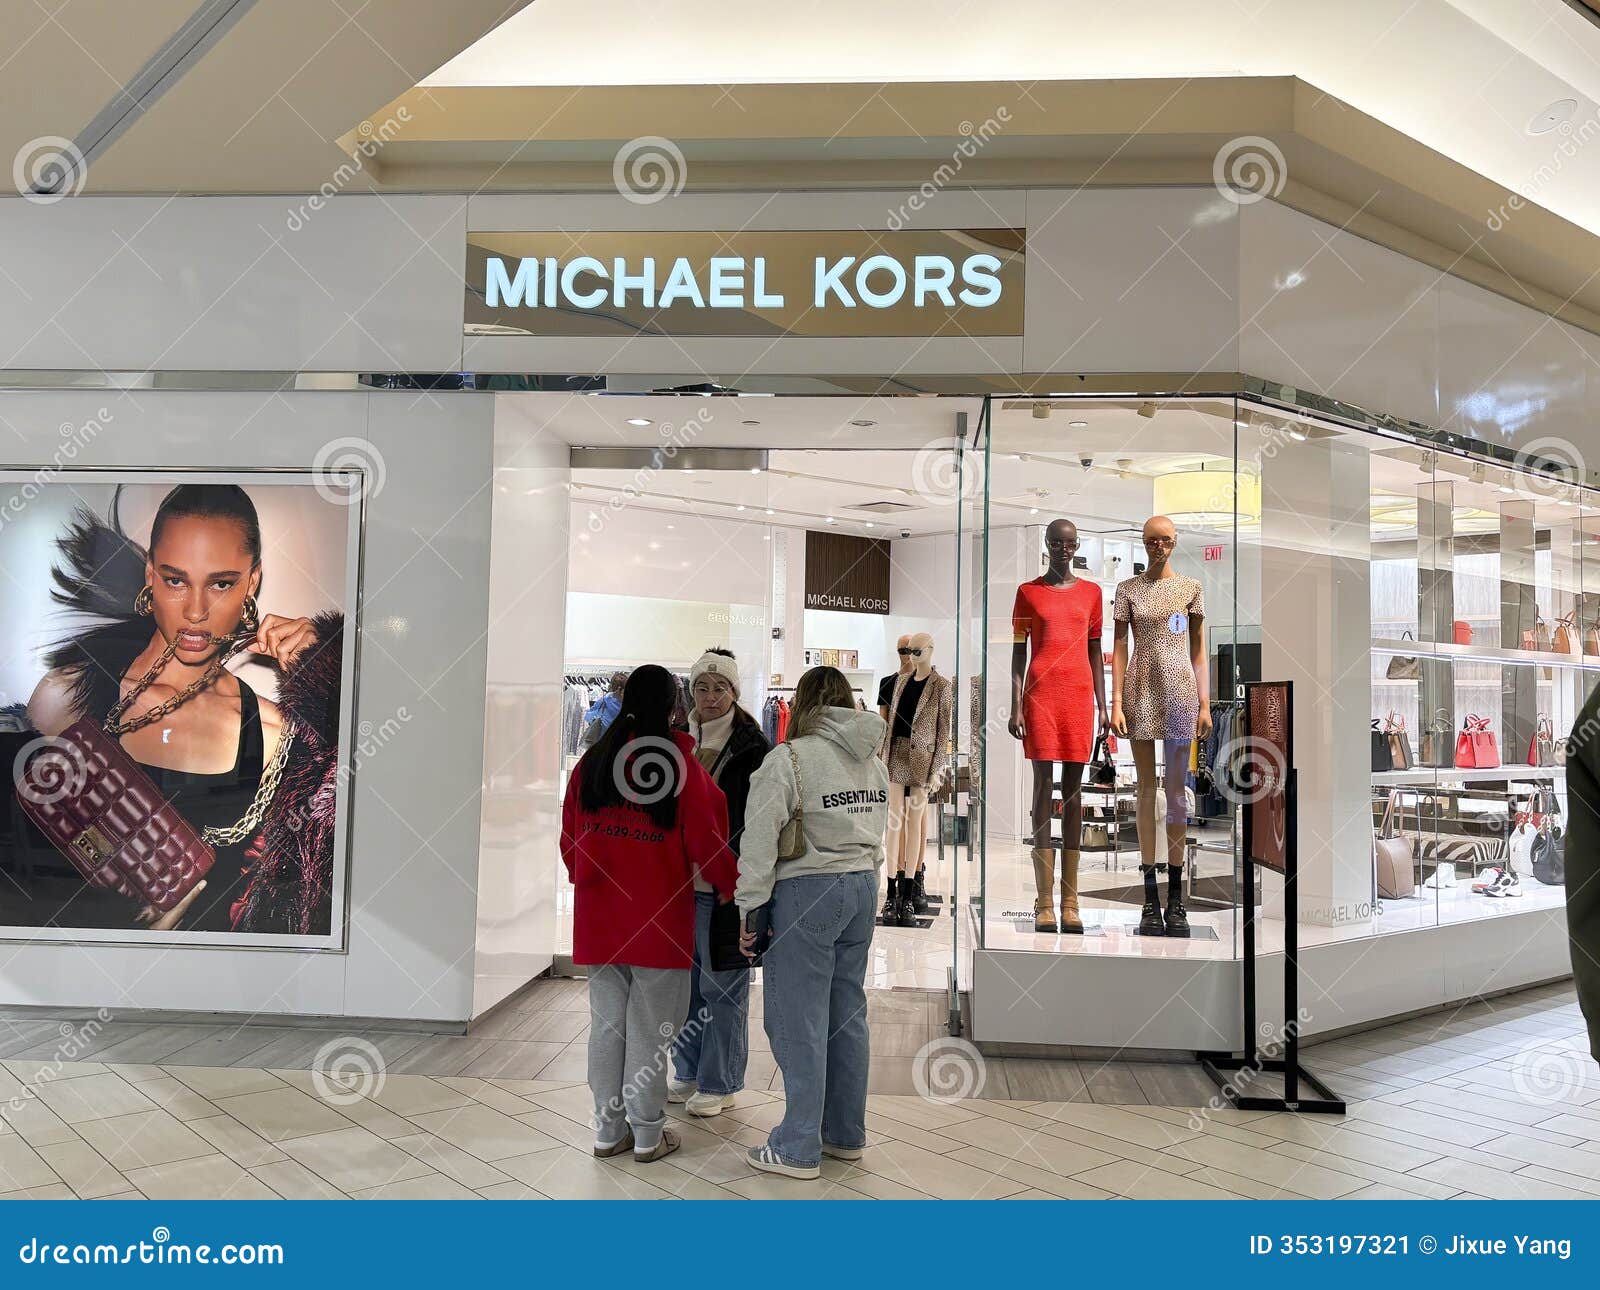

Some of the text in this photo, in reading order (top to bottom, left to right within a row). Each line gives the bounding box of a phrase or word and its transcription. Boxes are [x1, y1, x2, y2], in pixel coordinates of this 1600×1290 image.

[485, 254, 1002, 308] MICHAEL KORS
[1204, 546, 1222, 560] EXIT
[807, 593, 889, 611] MICHAEL KORS
[821, 789, 887, 809] ESSENTIALS
[1001, 910, 1032, 919] afterpay
[1354, 900, 1384, 920] KORS
